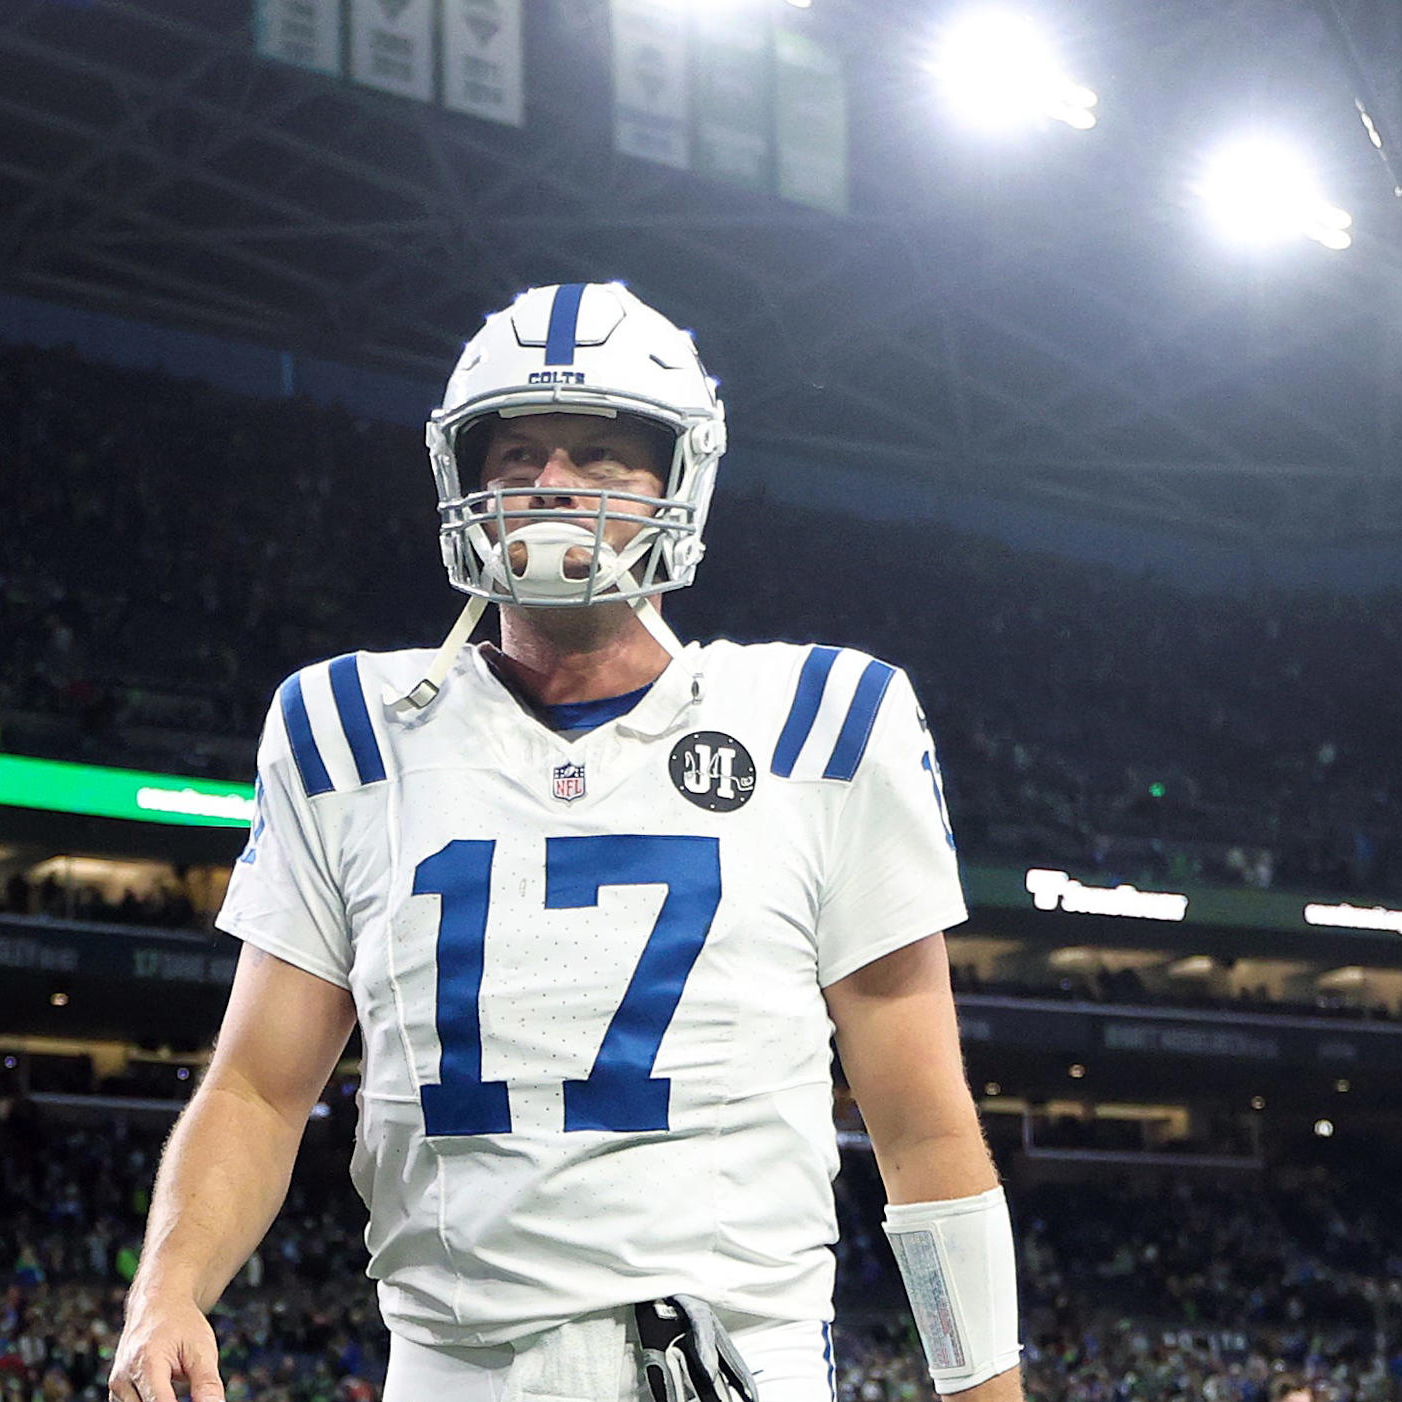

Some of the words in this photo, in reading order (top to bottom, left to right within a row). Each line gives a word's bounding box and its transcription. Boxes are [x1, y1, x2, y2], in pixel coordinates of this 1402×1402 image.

[529, 371, 585, 384] COLTS
[556, 779, 583, 796] NFL
[411, 834, 723, 1137] 17
